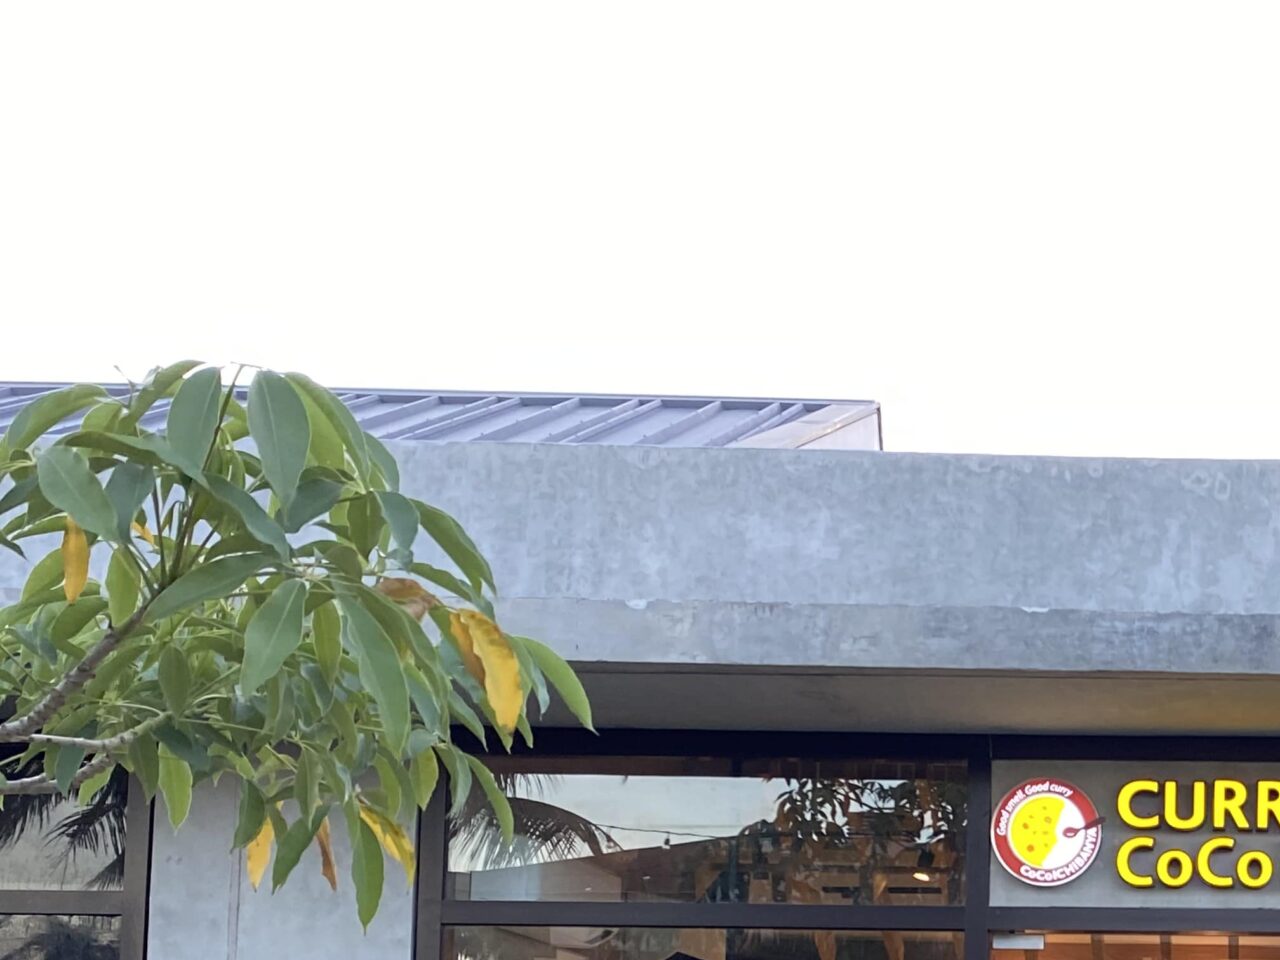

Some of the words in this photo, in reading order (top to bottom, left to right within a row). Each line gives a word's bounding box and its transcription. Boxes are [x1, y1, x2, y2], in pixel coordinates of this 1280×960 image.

[996, 809, 1010, 836] Good
[1024, 781, 1050, 795] Good
[1050, 783, 1073, 797] curry
